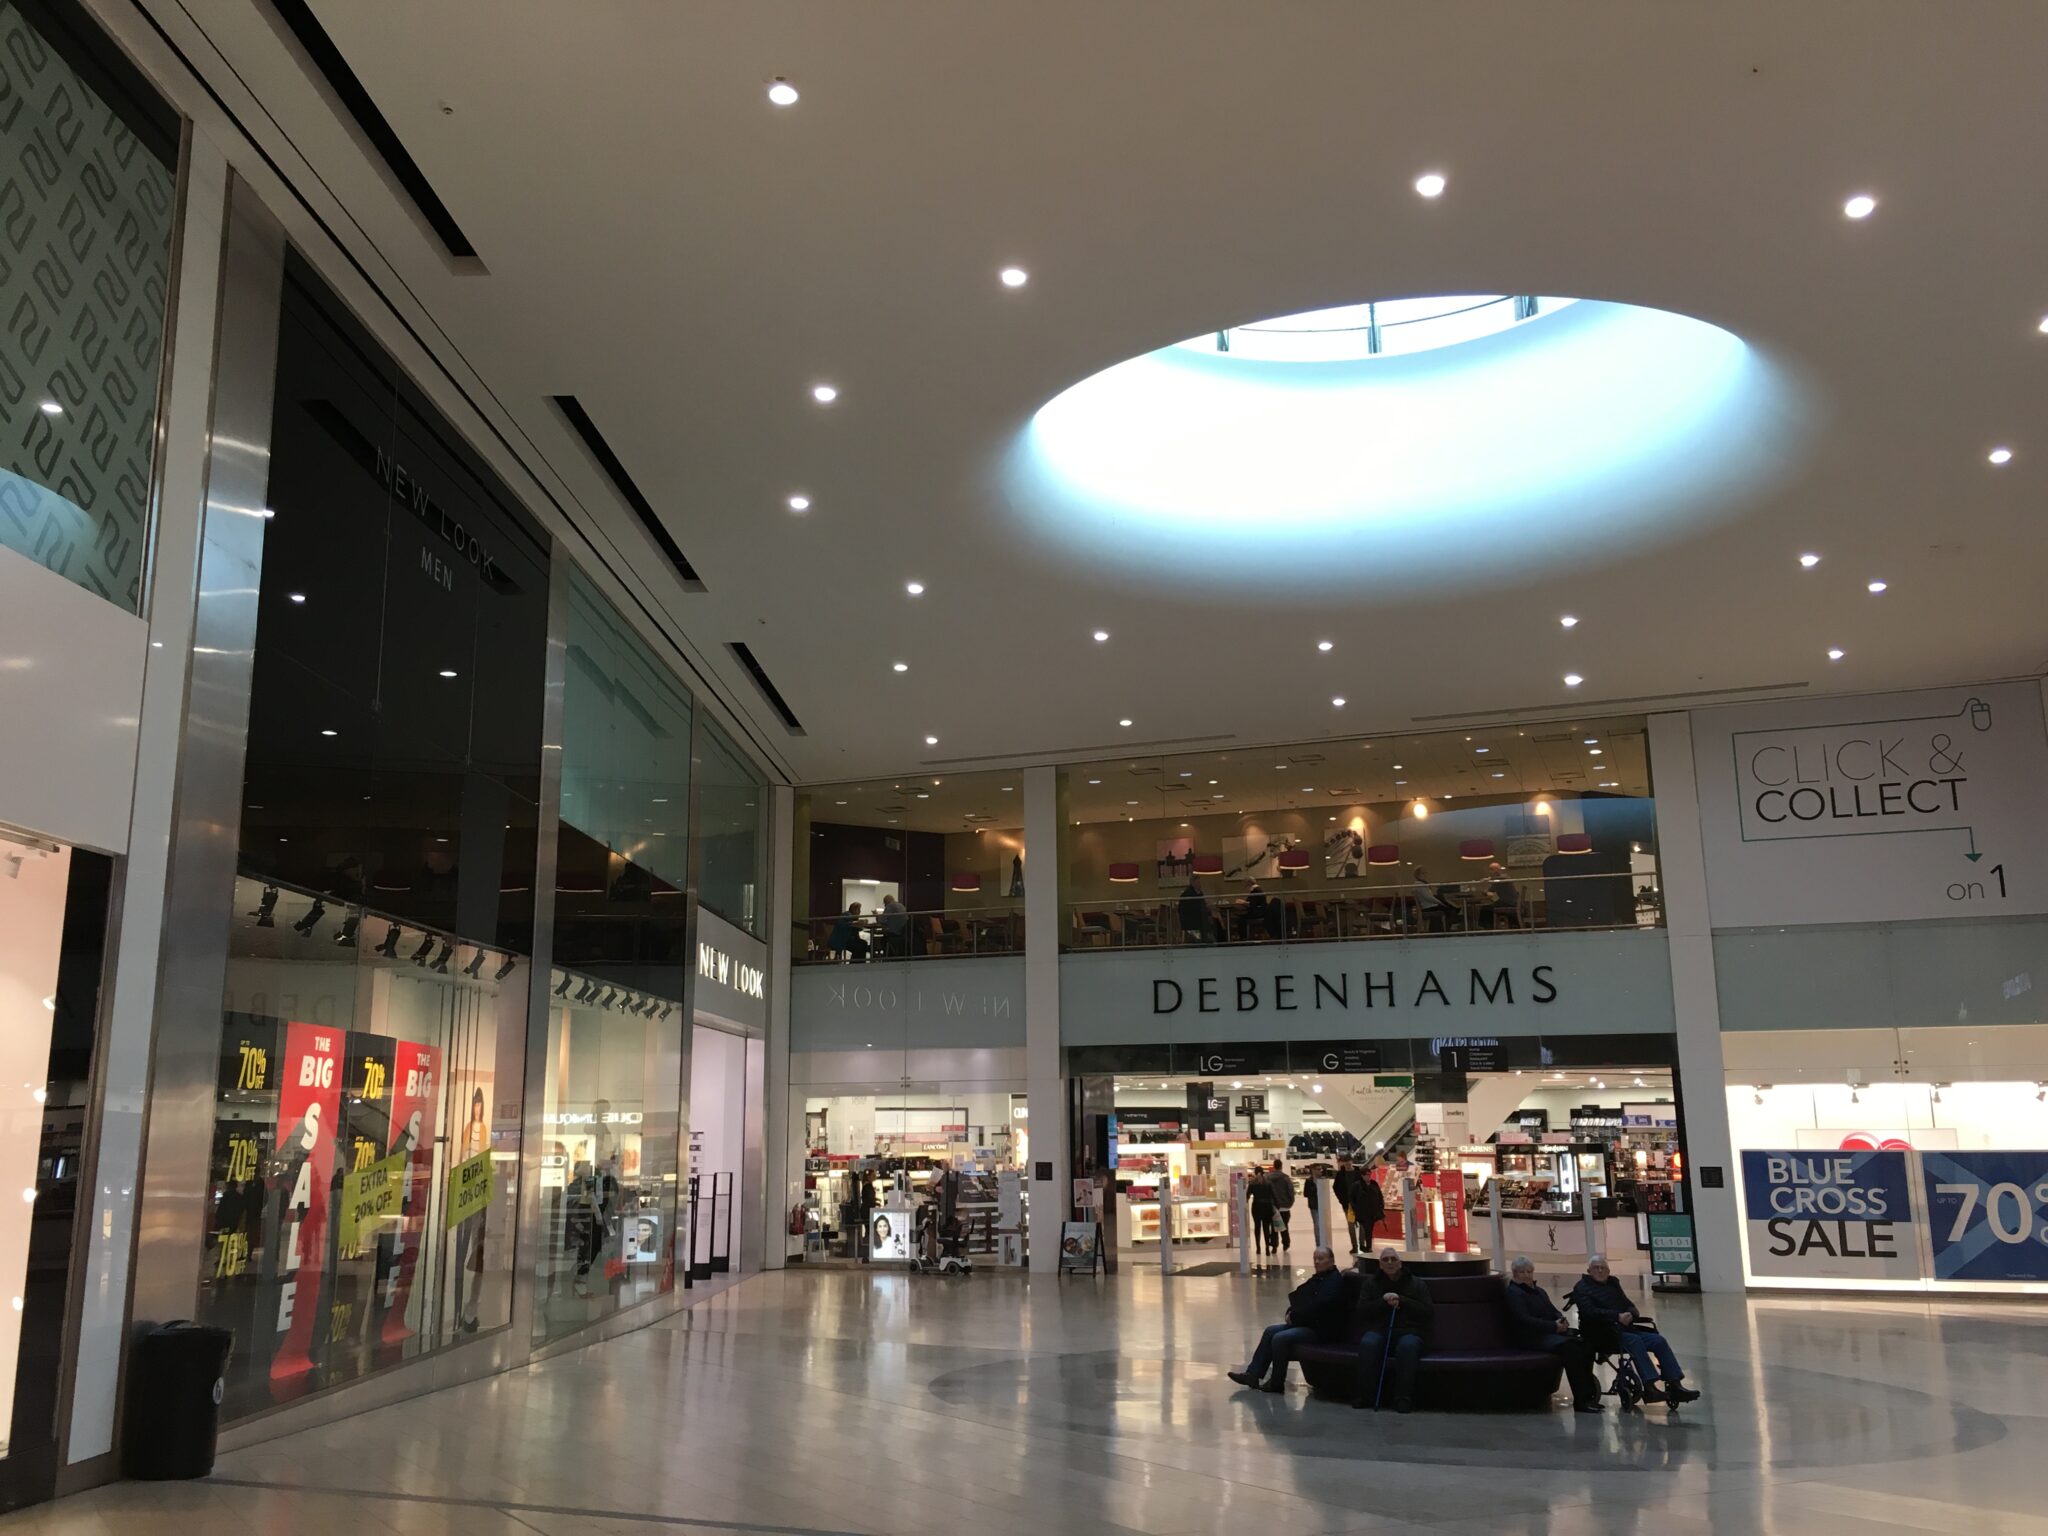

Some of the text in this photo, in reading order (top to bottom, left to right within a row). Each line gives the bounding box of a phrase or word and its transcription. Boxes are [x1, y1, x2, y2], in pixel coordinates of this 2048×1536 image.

[376, 445, 494, 580] NEW LOOK
[421, 546, 453, 591] MEN
[1751, 733, 1965, 786] CLICK &
[1755, 778, 1967, 822] COLLECT
[1946, 864, 2007, 900] on 1
[699, 942, 764, 1000] NEW LOOK
[1152, 965, 1558, 1014] DEBENHAMS
[315, 1036, 331, 1051] THE
[237, 1047, 267, 1089] 70%
[299, 1055, 334, 1089] BIG
[417, 1053, 430, 1066] THE
[1200, 1055, 1224, 1072] LG
[1323, 1053, 1339, 1070] G
[1451, 1051, 1458, 1068] 1
[254, 1075, 265, 1089] OFF
[405, 1069, 433, 1098] BIG
[1207, 1099, 1218, 1109] LG
[226, 1139, 258, 1182] 70%
[462, 1160, 484, 1185] EXTRA
[1767, 1157, 1855, 1185] BLUE
[360, 1167, 388, 1195] EXTRA
[458, 1179, 488, 1208] 20% OFF
[354, 1190, 392, 1223] 20% OFF
[1770, 1187, 1888, 1214] CROSS
[1935, 1182, 2048, 1244] 70
[1767, 1217, 1898, 1258] SALE
